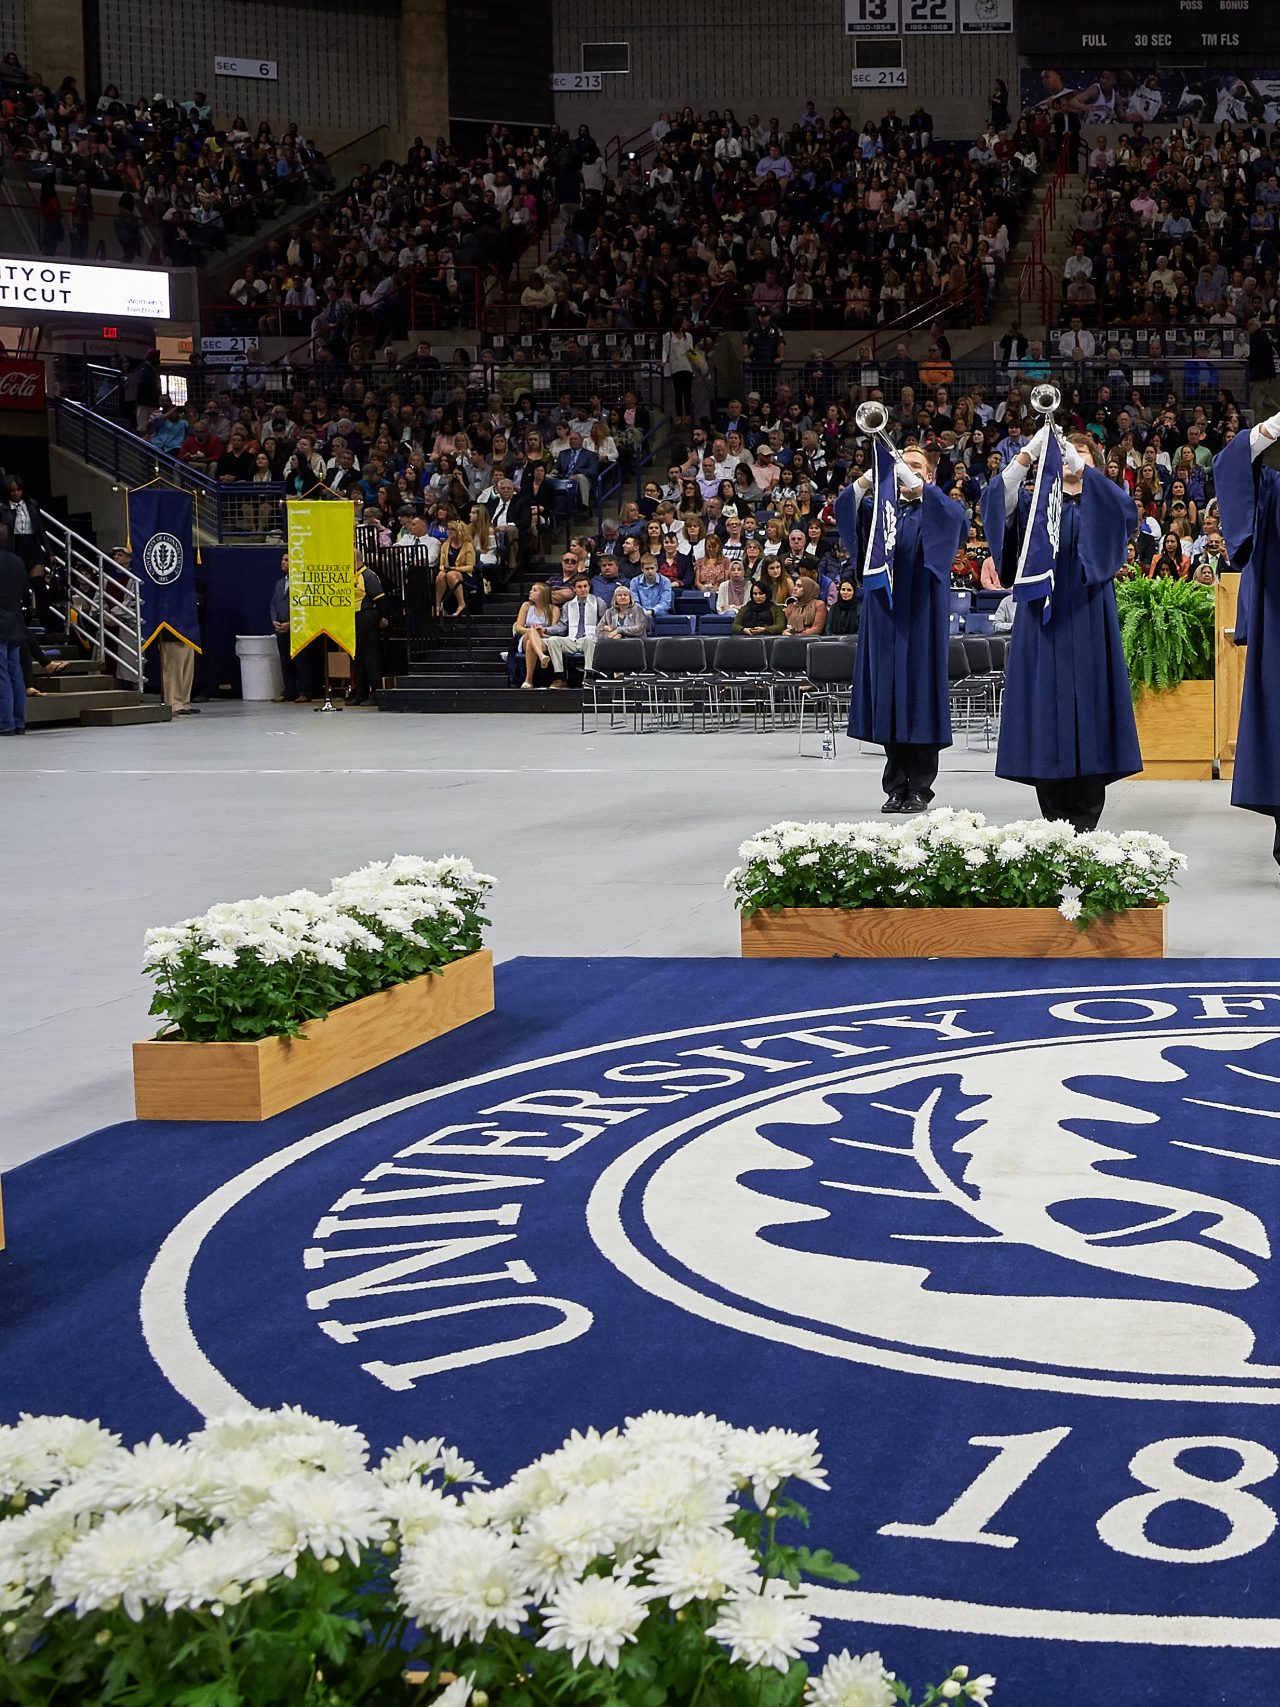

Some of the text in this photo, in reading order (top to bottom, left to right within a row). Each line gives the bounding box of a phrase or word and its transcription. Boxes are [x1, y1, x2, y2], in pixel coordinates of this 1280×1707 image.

[1179, 0, 1203, 10] POSS
[1219, 0, 1249, 10] BONUS
[1081, 34, 1108, 47] FULL
[1134, 34, 1173, 46] 30 SEC
[1201, 33, 1240, 46] TM FLS
[216, 61, 270, 76] SEC 6
[574, 75, 601, 88] 213
[853, 71, 906, 84] SEC 214
[0, 265, 72, 284] TY OF
[0, 285, 72, 304] TICUT
[203, 338, 257, 350] SEC 213
[302, 571, 352, 584] LIBERAL
[304, 583, 336, 595] ARTS
[292, 595, 352, 607] SCIENCES
[302, 1009, 995, 1392] UNIVERSITY
